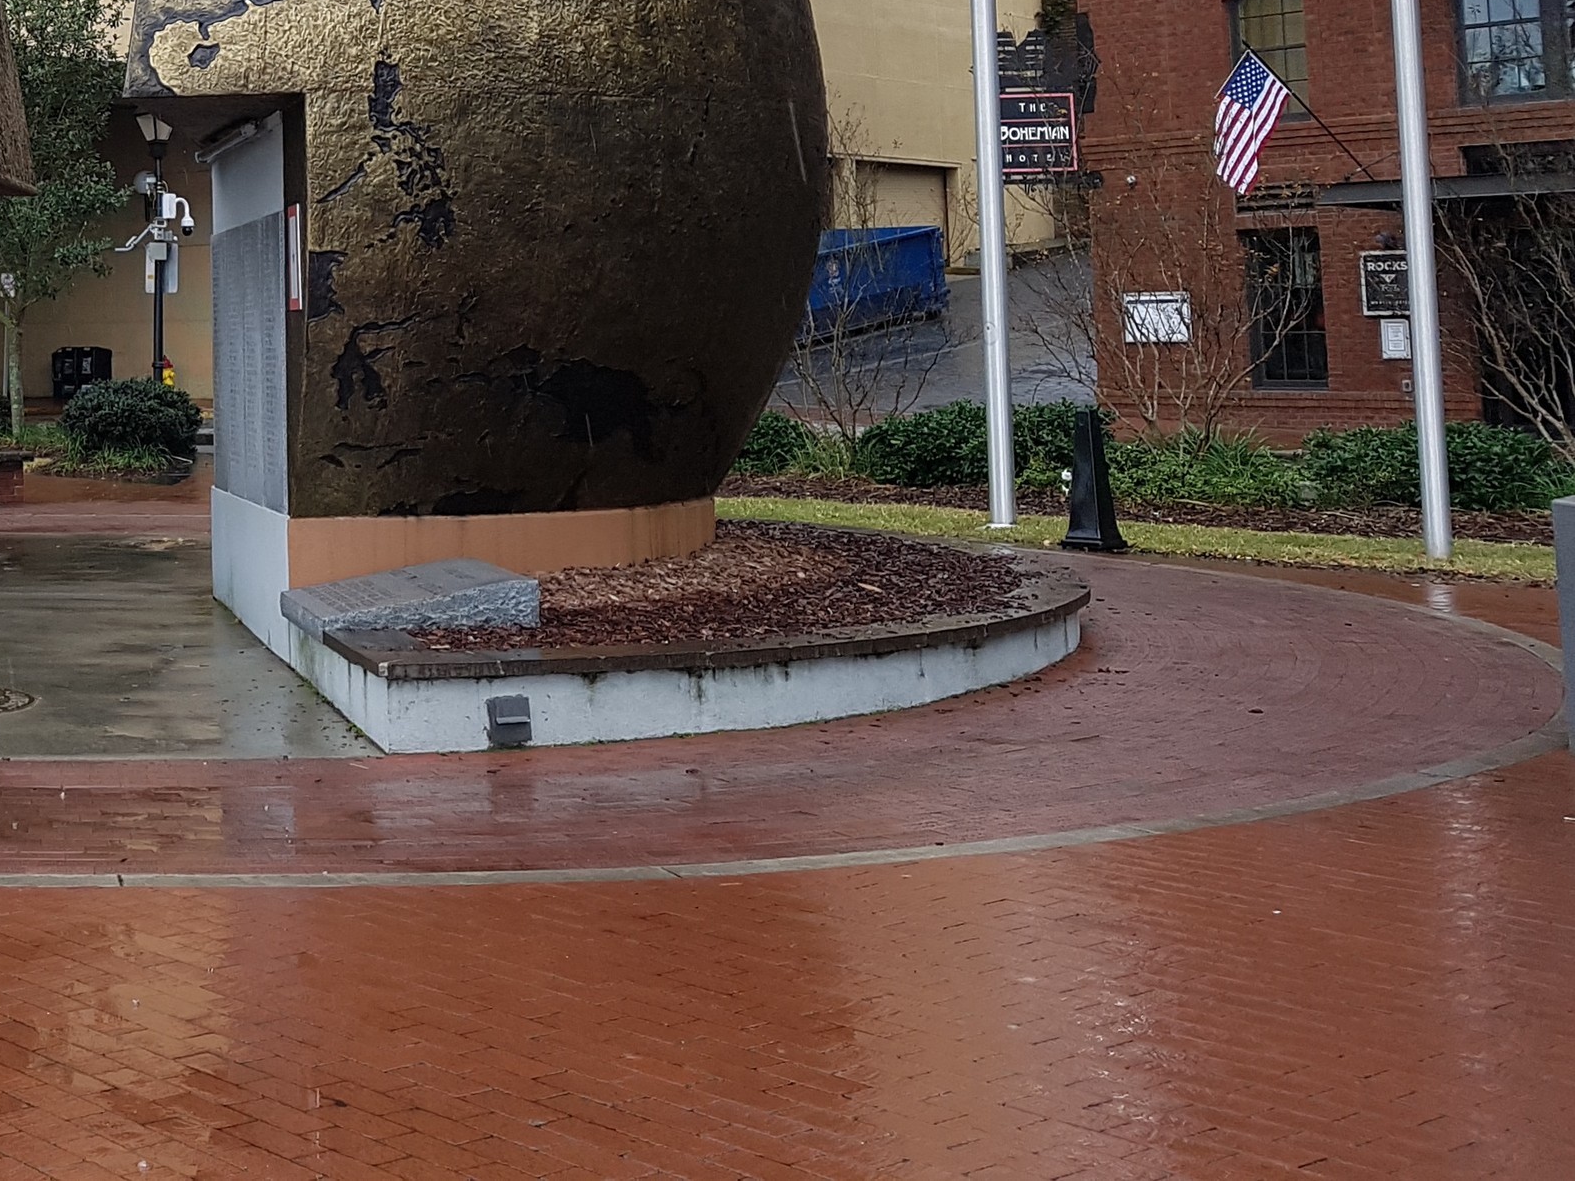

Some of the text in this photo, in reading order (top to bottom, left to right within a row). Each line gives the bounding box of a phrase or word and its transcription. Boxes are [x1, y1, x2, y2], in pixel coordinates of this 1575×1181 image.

[1018, 103, 1047, 113] THE
[1000, 126, 1069, 140] BOHEMIAN
[1366, 261, 1408, 271] ROCKS
